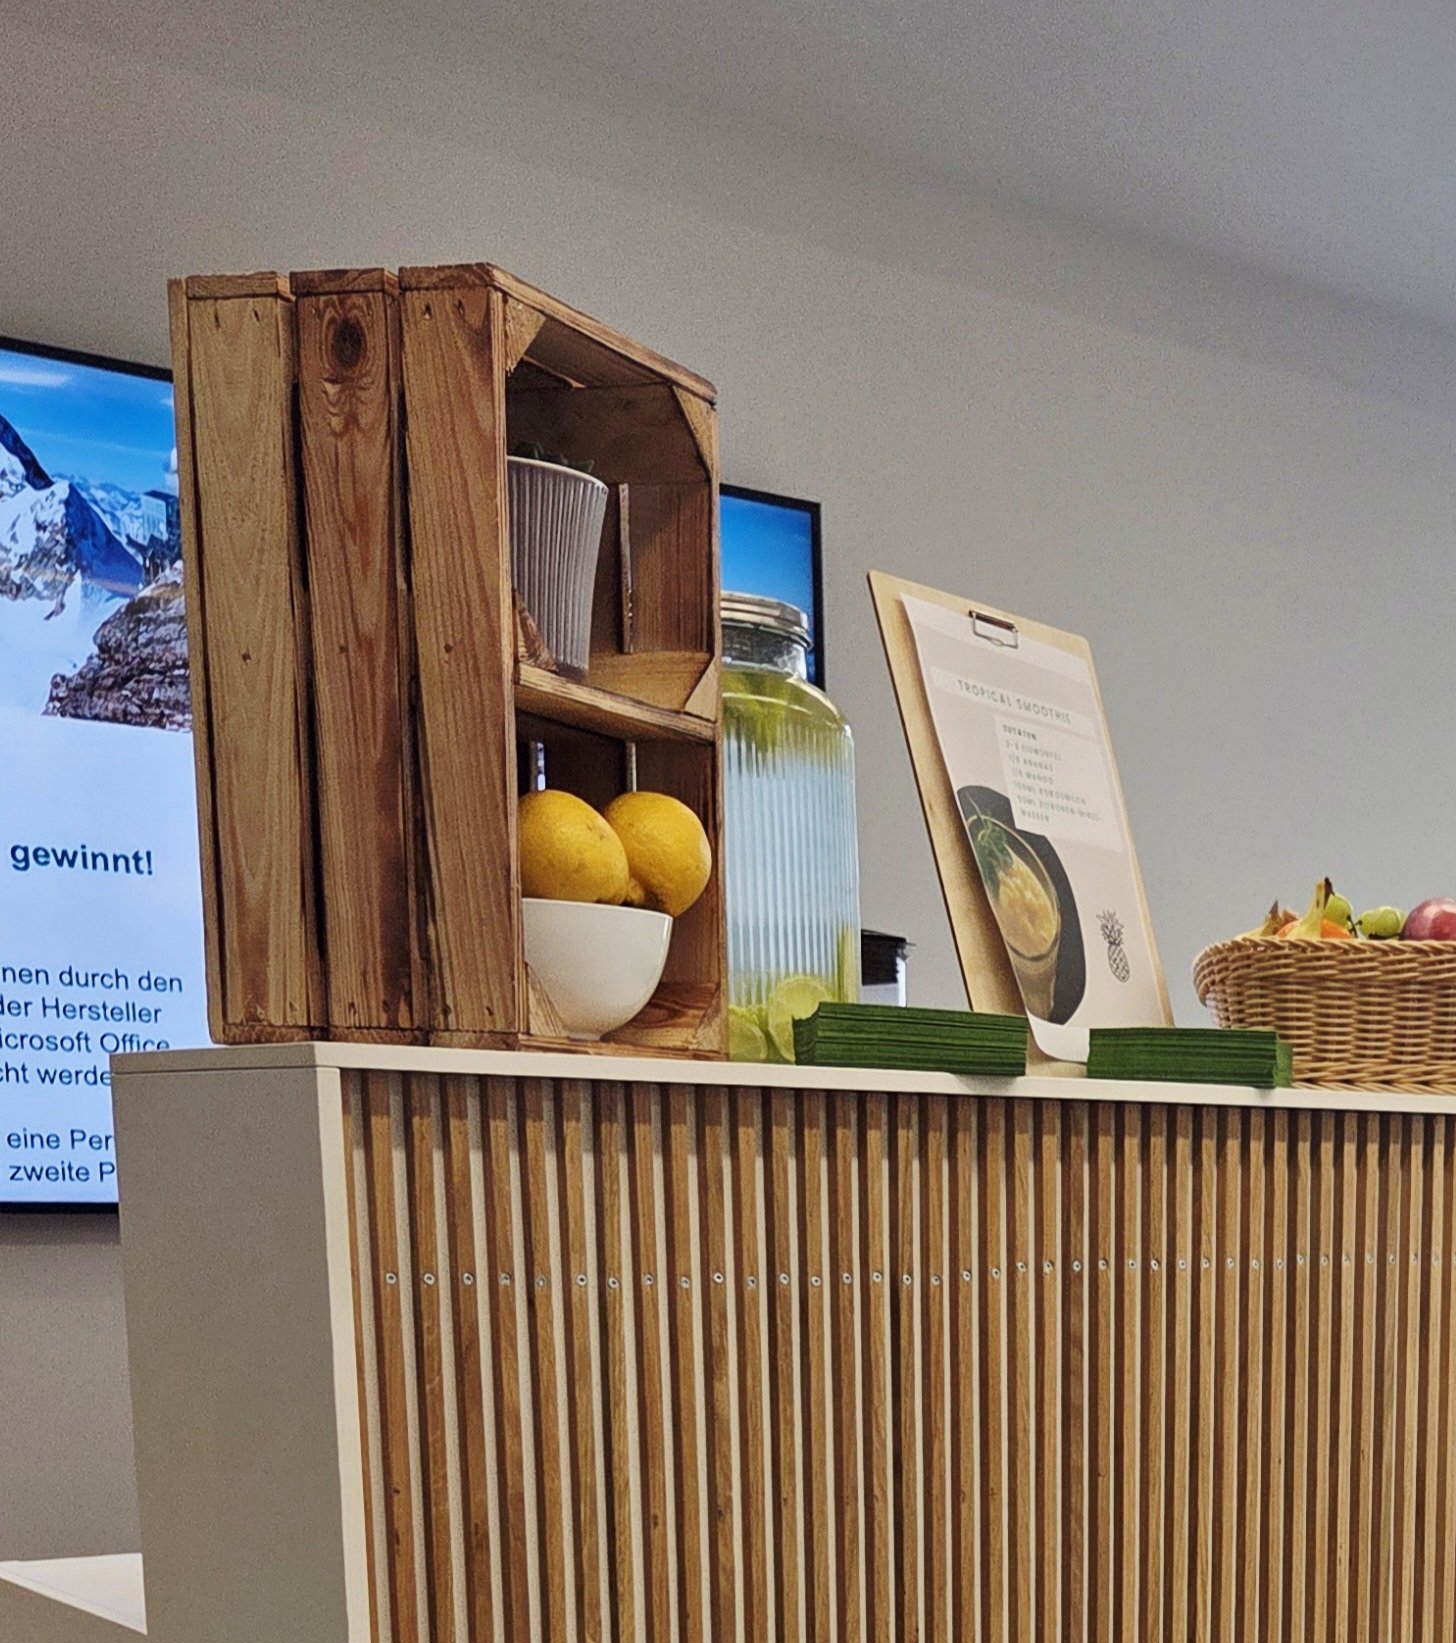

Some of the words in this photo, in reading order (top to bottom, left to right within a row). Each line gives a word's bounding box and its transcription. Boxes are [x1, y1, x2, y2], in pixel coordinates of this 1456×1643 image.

[957, 679, 1012, 707] TROPICAL
[1016, 698, 1072, 725] SMOOTHIE
[10, 844, 153, 876] gewinnt!
[2, 966, 49, 985] nen
[58, 964, 129, 991] durch
[138, 970, 183, 993] den
[41, 996, 162, 1024] Hersteller
[0, 1061, 30, 1085] ht
[7, 1127, 60, 1150] eine
[70, 1128, 113, 1151] Per
[9, 1160, 90, 1183] zweite
[99, 1161, 115, 1183] P
